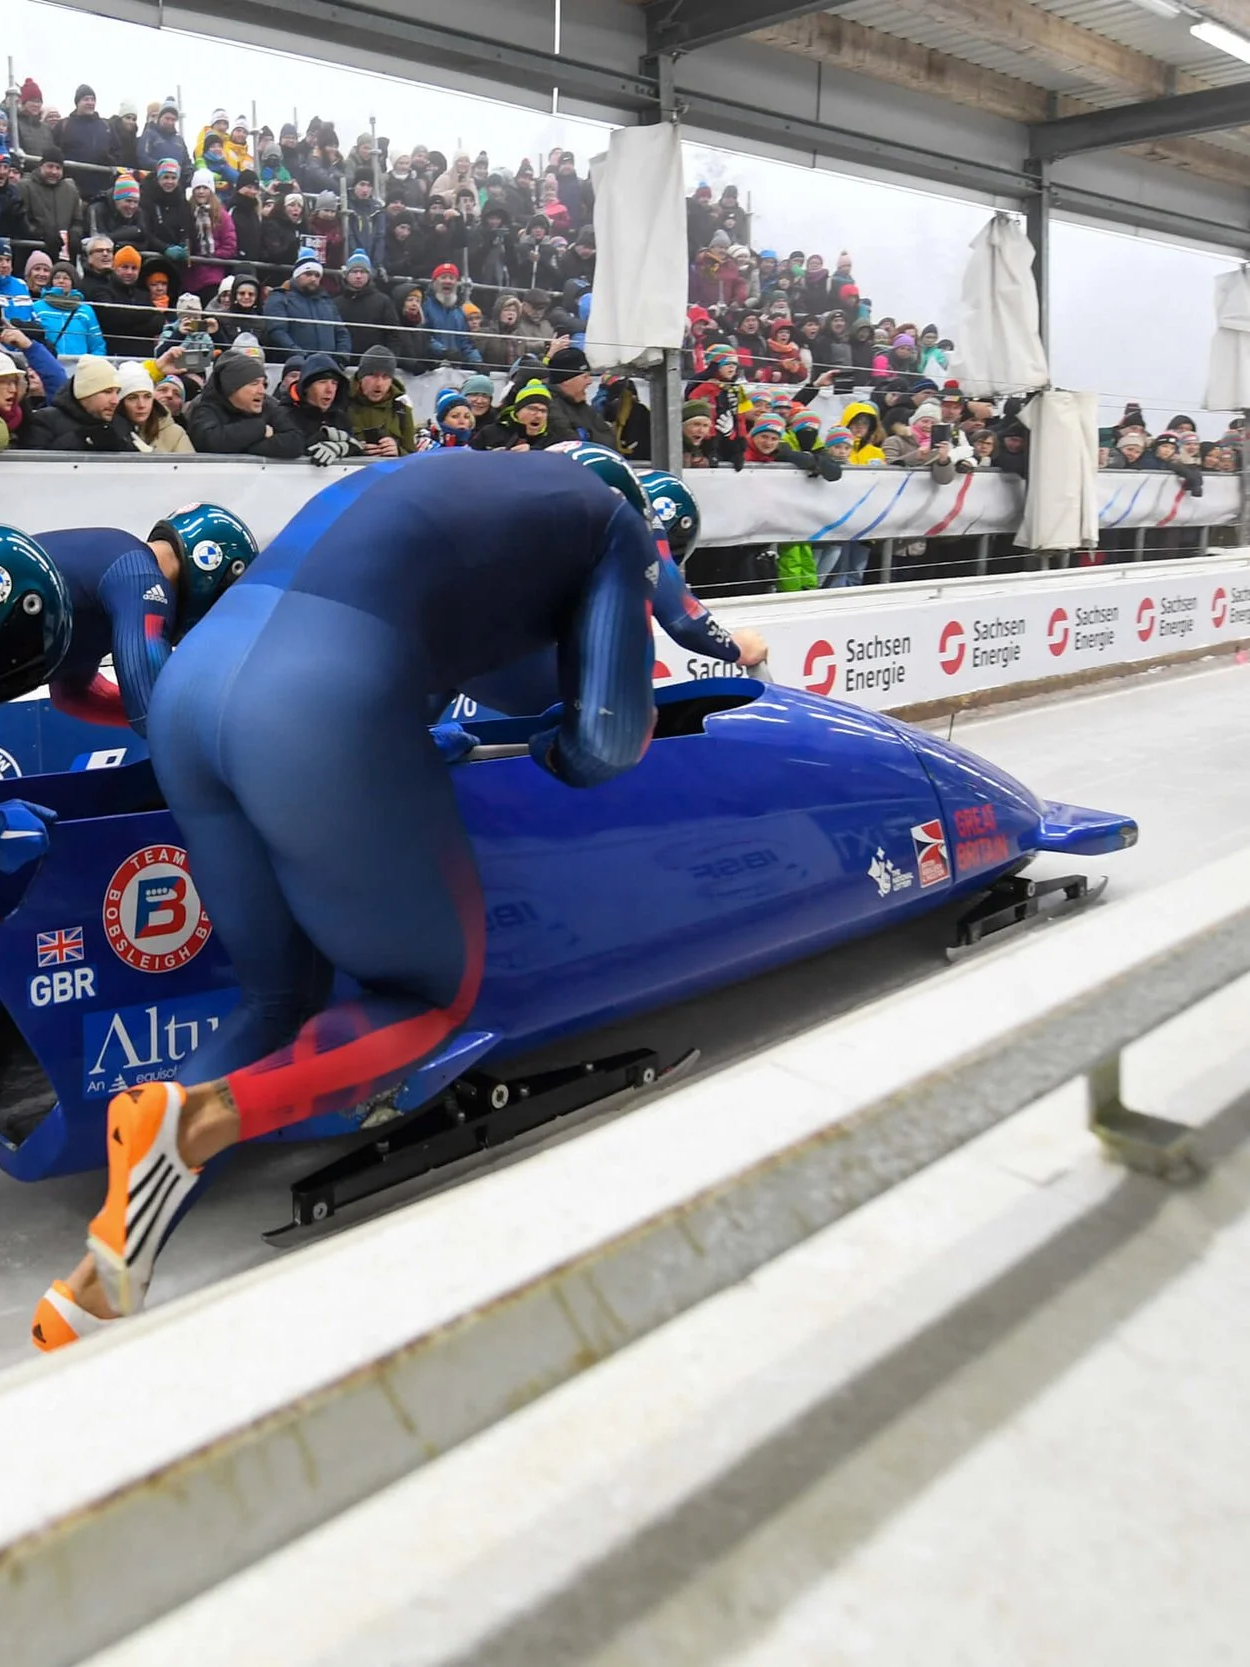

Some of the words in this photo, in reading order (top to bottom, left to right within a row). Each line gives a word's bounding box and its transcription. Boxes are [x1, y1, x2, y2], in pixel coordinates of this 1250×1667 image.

[1075, 605, 1119, 627] Sachsen
[1160, 595, 1197, 615] Sachsen
[973, 617, 1025, 642] Sachsen
[1074, 627, 1115, 651] Energie
[1159, 615, 1195, 638] Energie
[845, 635, 911, 663] Sachsen
[972, 641, 1021, 668] Energie
[845, 662, 905, 692] Energie
[953, 804, 997, 838] GREAT
[130, 848, 186, 870] TEAM
[106, 888, 192, 970] BOBSLEIGH
[30, 967, 96, 1007] GBR
[87, 1080, 105, 1093] An
